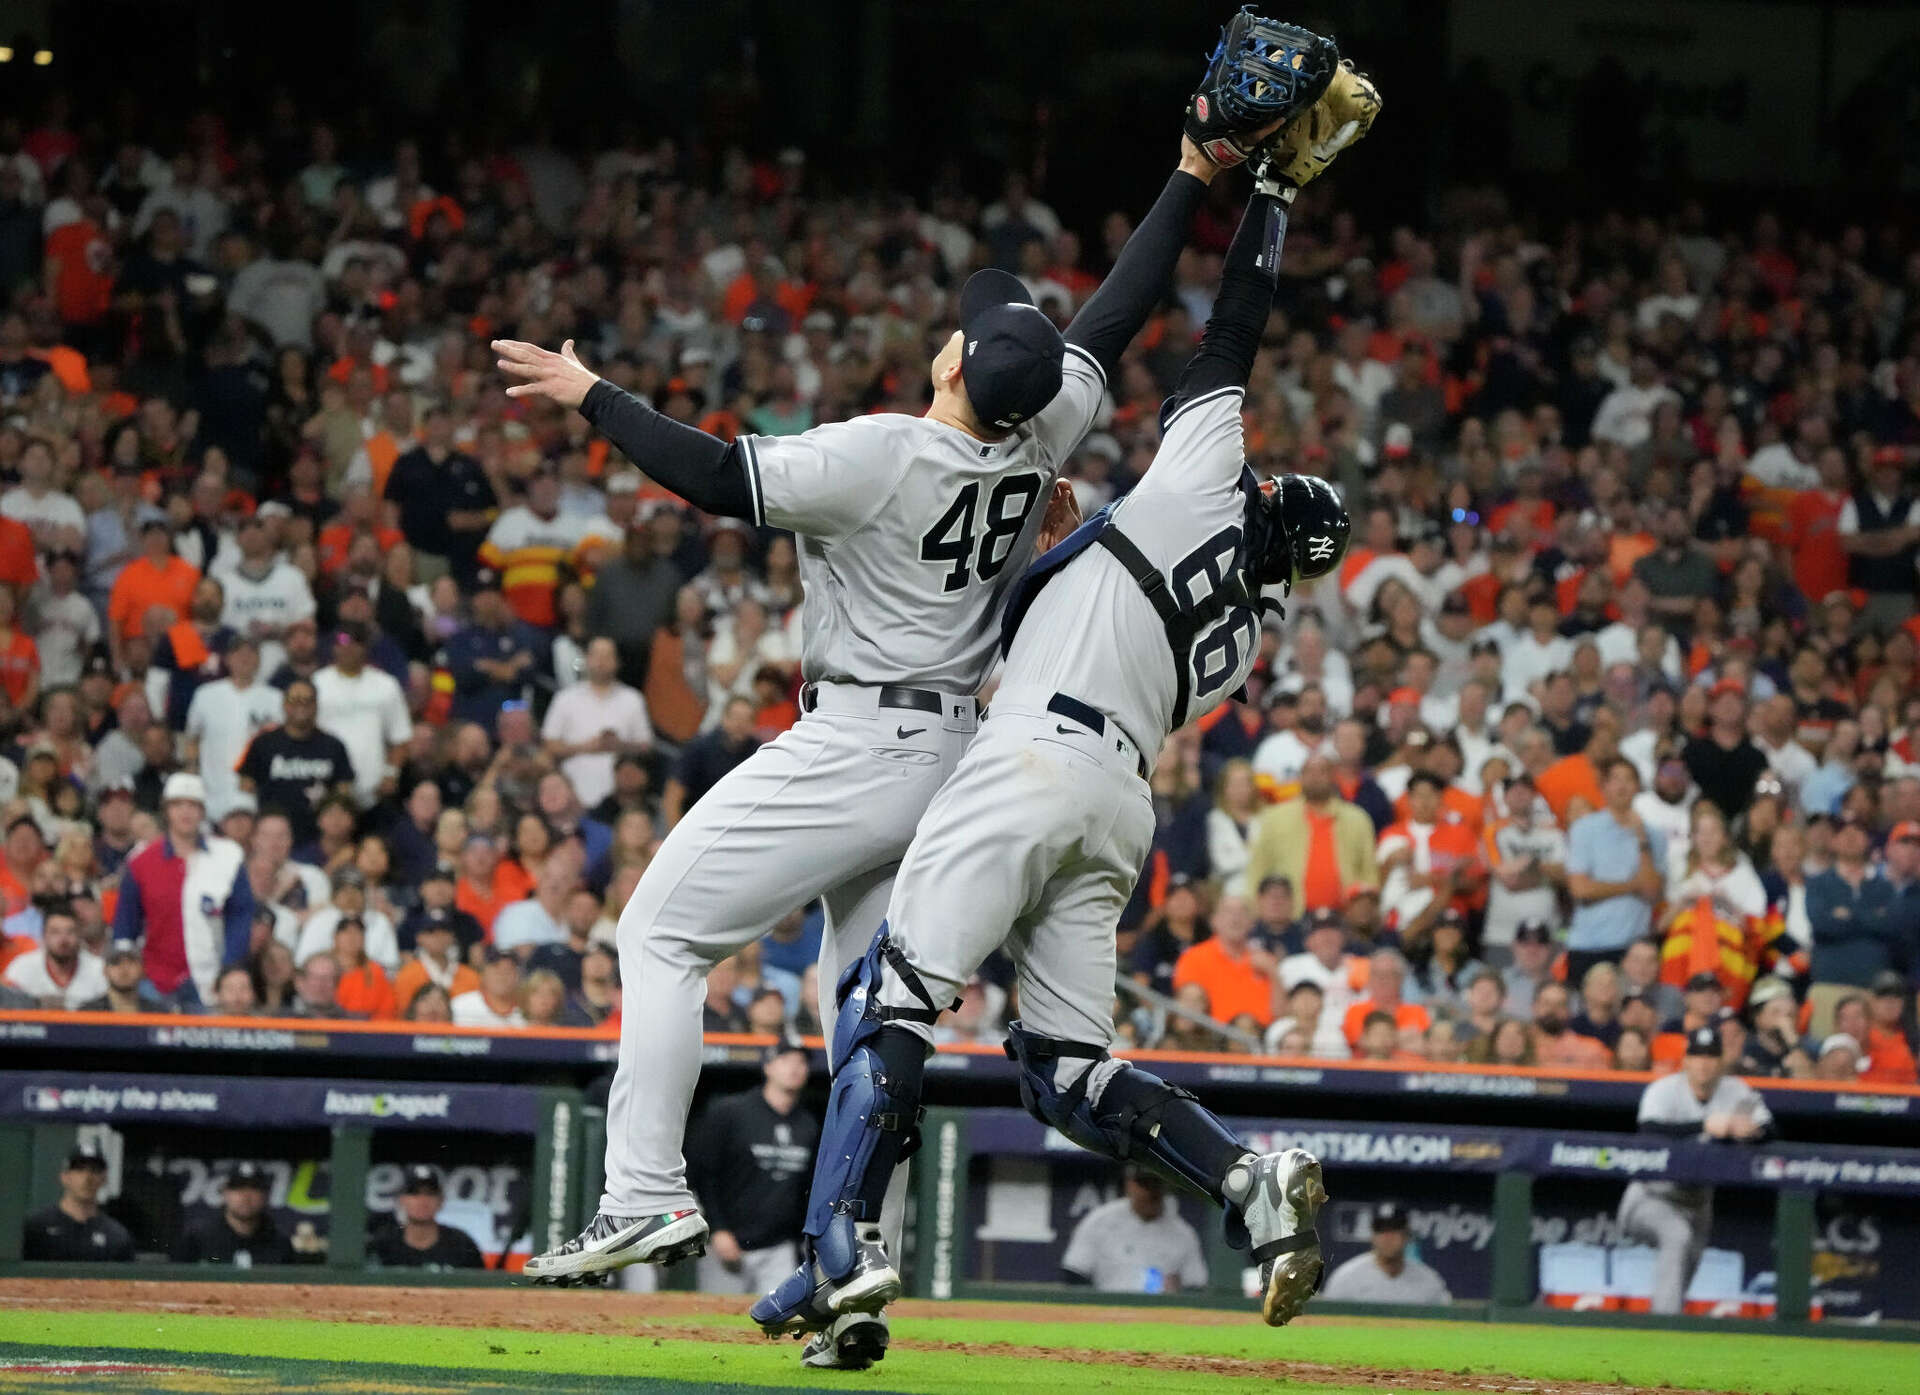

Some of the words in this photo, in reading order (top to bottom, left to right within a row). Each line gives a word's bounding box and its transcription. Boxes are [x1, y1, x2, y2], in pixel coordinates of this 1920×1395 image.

[918, 469, 1043, 595] 48
[1308, 535, 1335, 561] NY
[1168, 520, 1262, 700] 66
[61, 1085, 119, 1113] enjoy
[121, 1086, 157, 1110] the
[1272, 1130, 1451, 1164] POSTSEASON
